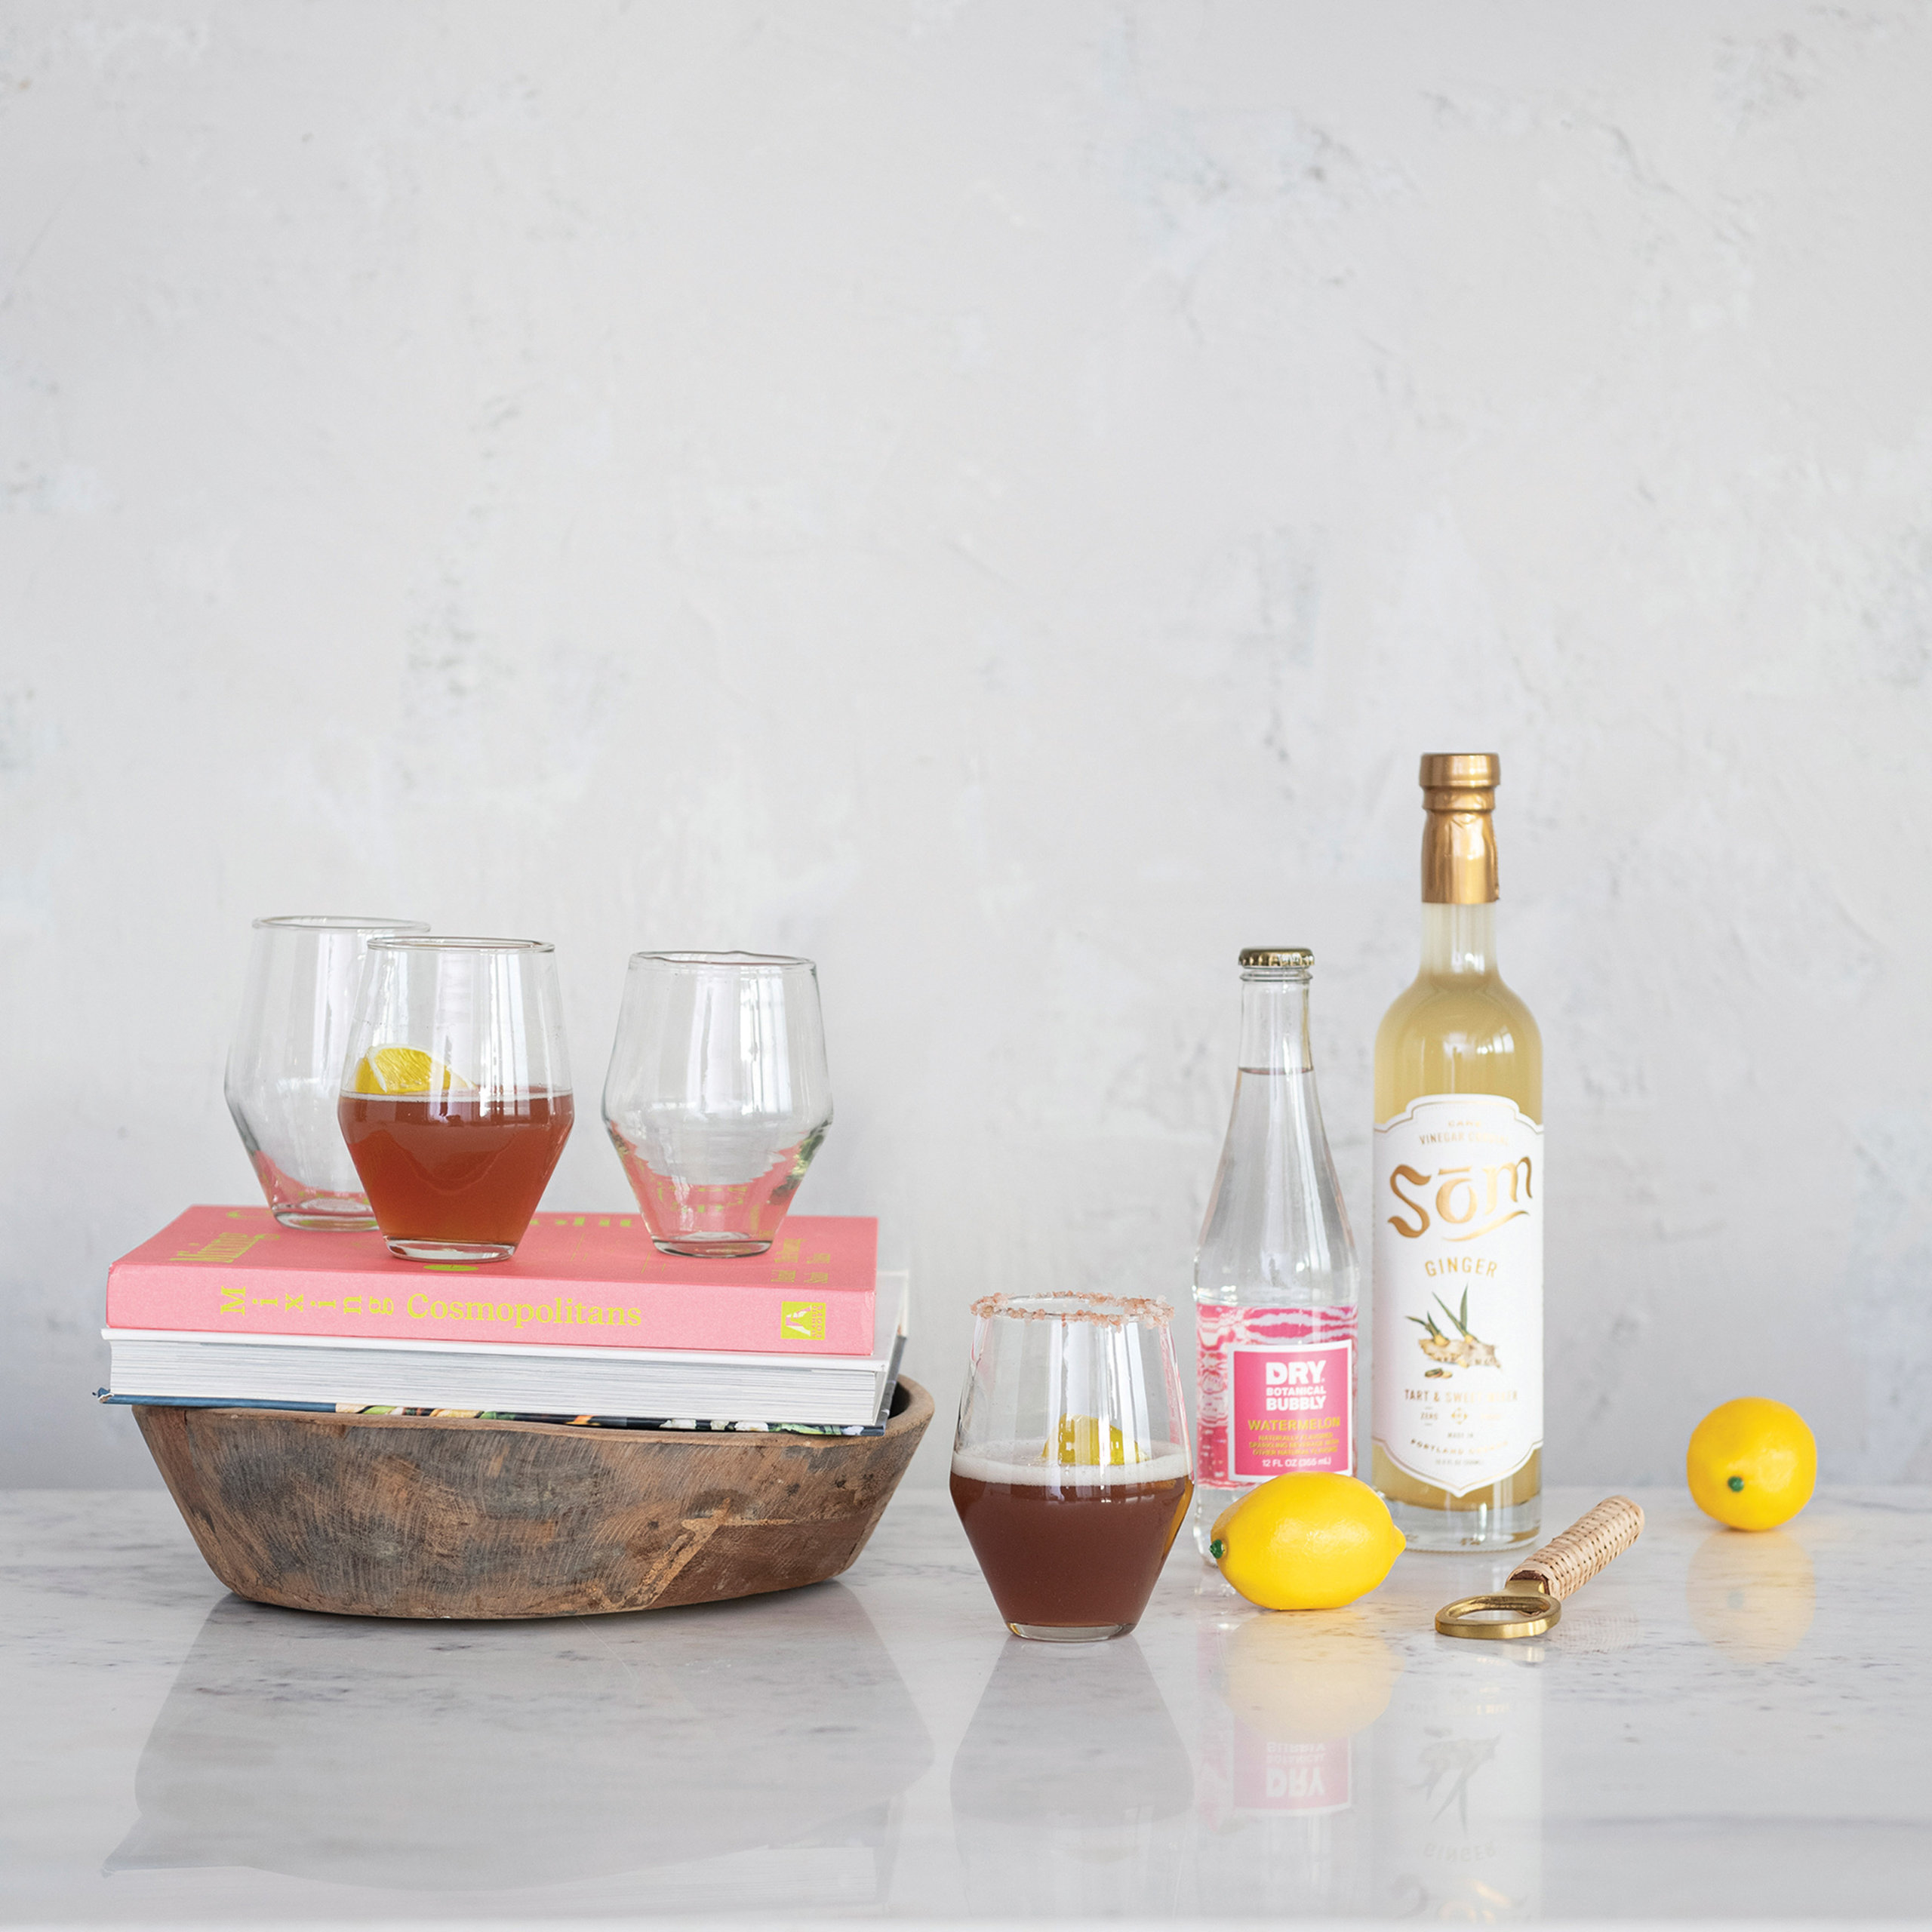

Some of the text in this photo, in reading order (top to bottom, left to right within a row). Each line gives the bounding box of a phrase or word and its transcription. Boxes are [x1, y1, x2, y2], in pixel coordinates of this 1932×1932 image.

[1419, 1132, 1464, 1145] VINEGAR
[1425, 1257, 1497, 1278] GINGER
[220, 1285, 642, 1328] Mixing Cosmopolitans
[1266, 1386, 1326, 1397] BOTANICAL
[1404, 1389, 1429, 1401] TART
[1433, 1391, 1440, 1402] &
[1266, 1396, 1326, 1411] BUBBLY
[1248, 1417, 1340, 1431] WATERMELON
[1262, 1459, 1270, 1467] 12
[1272, 1459, 1283, 1467] FL
[1284, 1459, 1297, 1467] OZ
